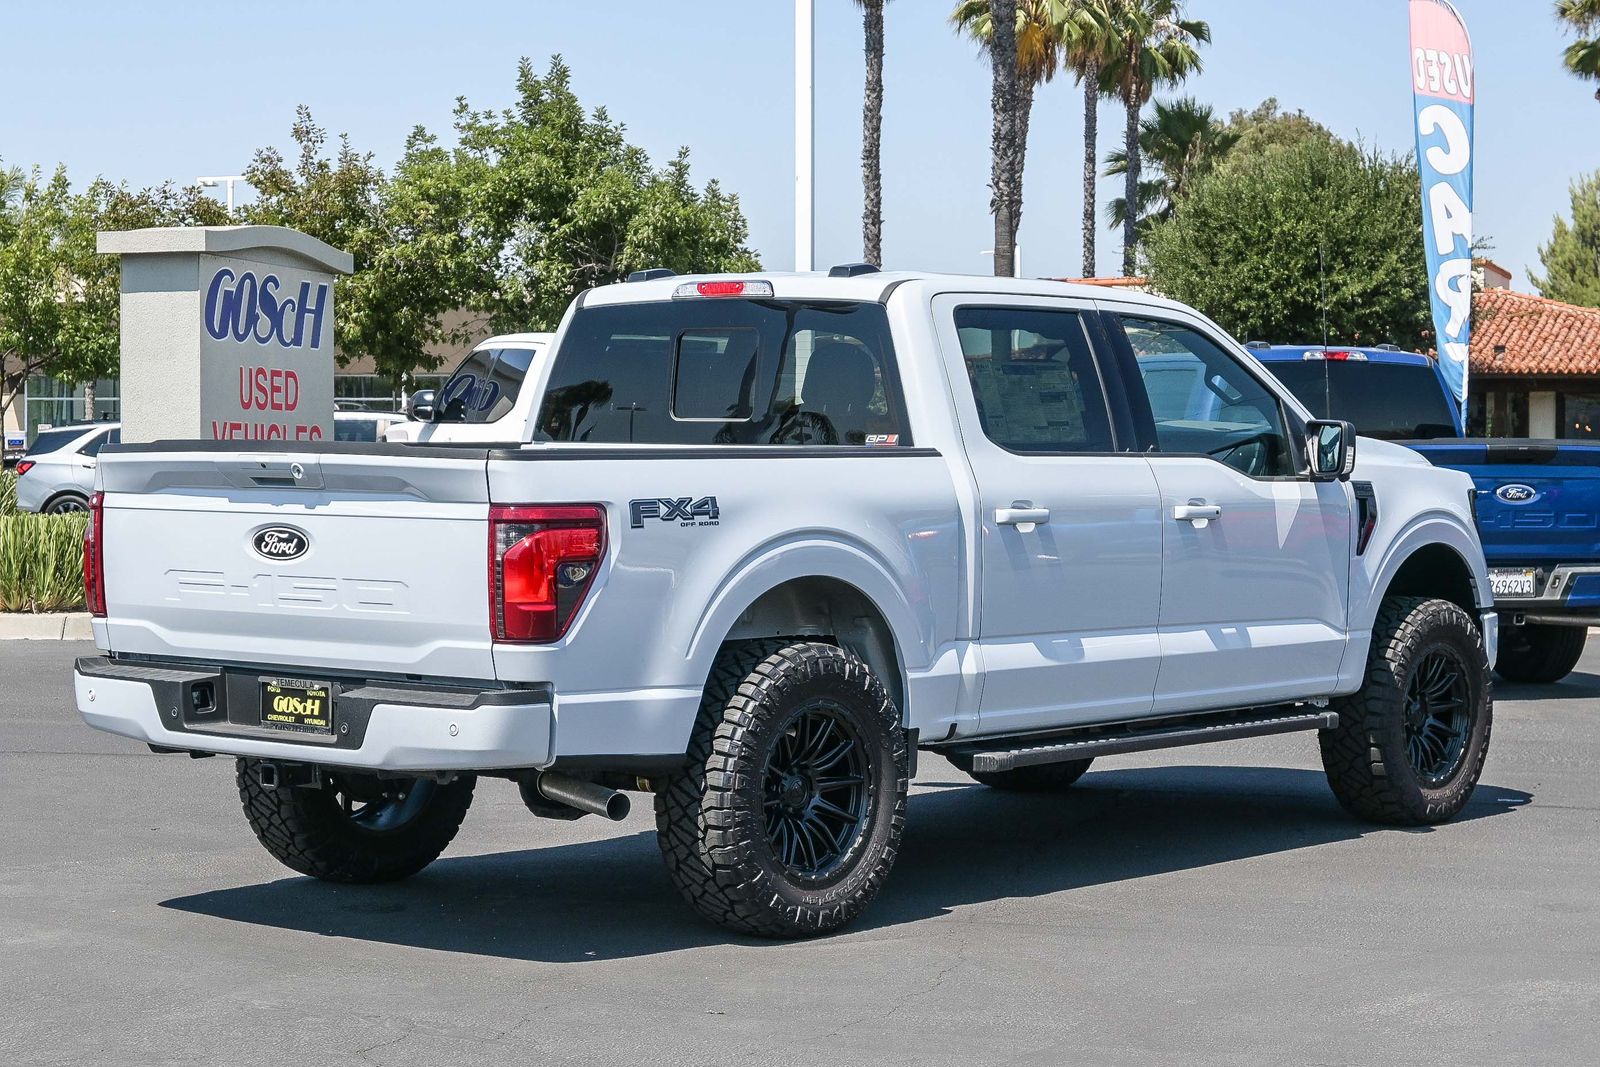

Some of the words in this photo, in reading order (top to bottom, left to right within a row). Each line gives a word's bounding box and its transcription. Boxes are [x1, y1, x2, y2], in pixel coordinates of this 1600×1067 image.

[239, 366, 300, 412] USED
[628, 496, 720, 529] FX4
[1481, 510, 1598, 529] -150
[260, 531, 298, 554] Ford
[164, 569, 410, 615] F-150
[275, 679, 315, 689] TEMECULA
[306, 690, 326, 698] TOYOTA
[267, 714, 295, 722] CHEVROLET
[304, 717, 326, 726] HYUNDAI
